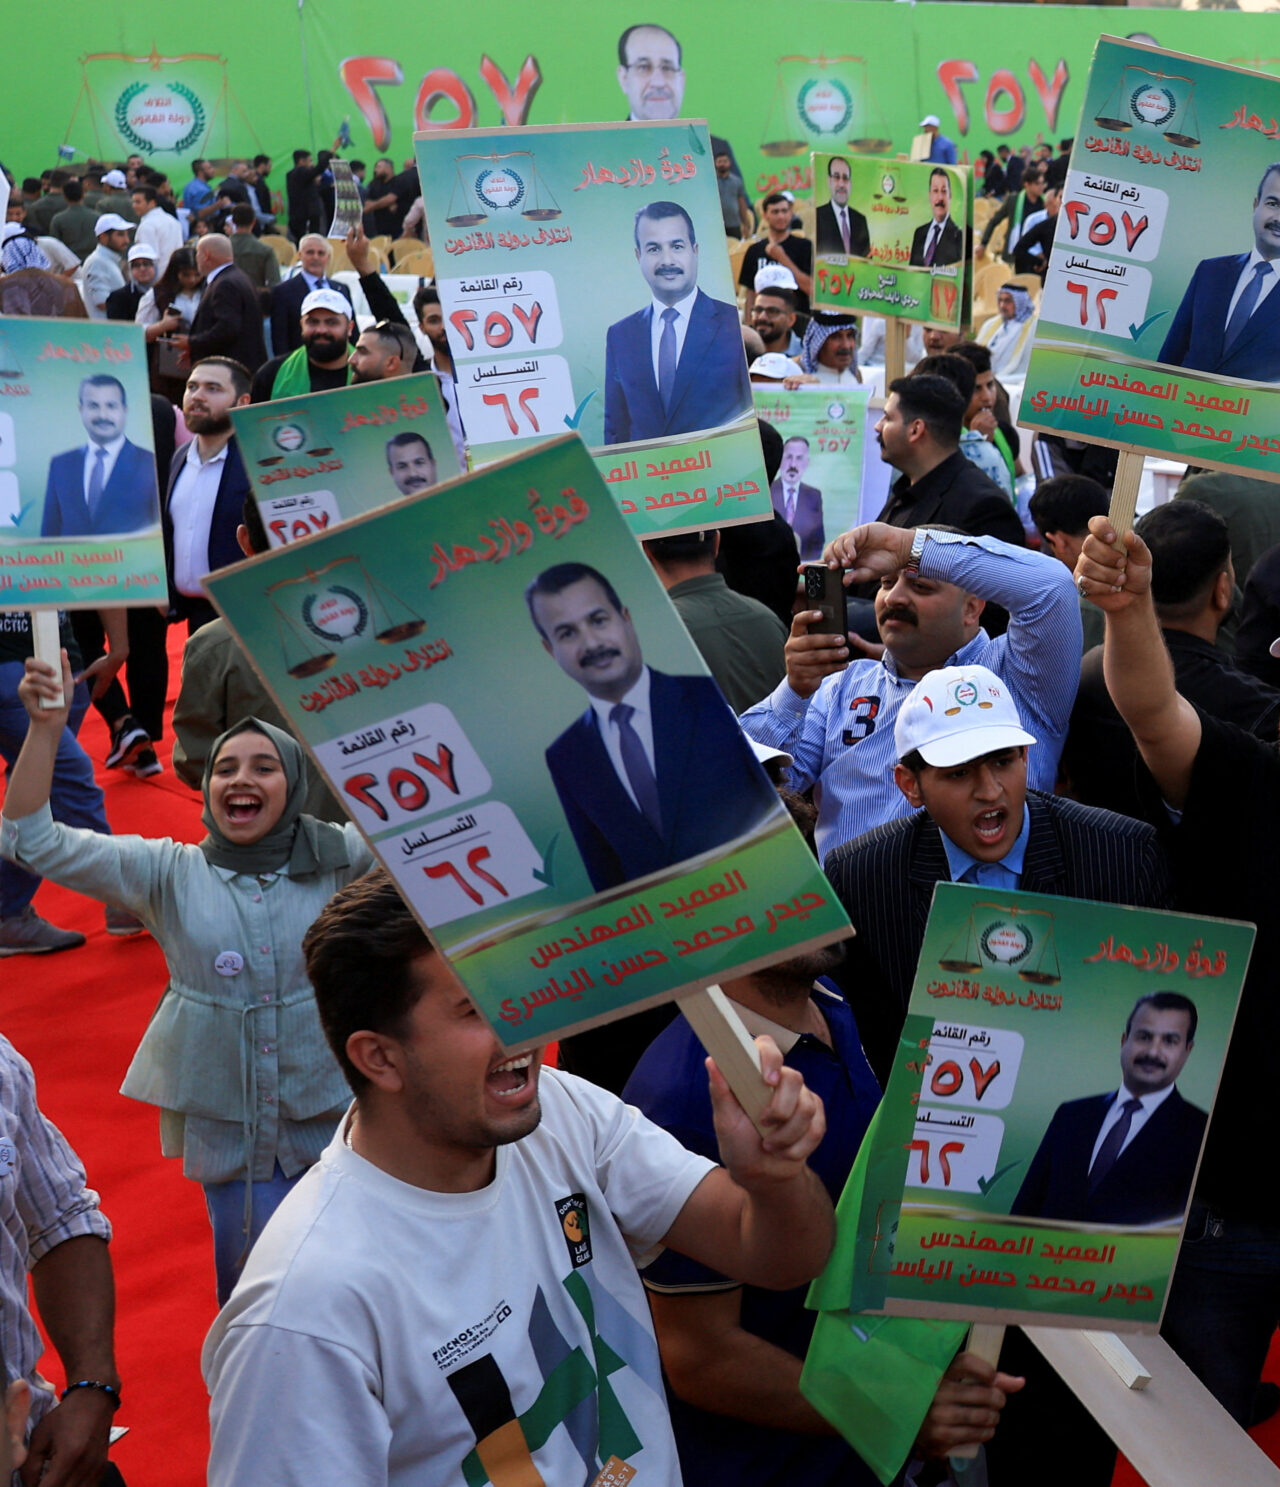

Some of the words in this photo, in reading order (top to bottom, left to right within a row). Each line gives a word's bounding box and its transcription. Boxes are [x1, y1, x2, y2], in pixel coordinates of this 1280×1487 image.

[339, 53, 542, 153] ٢٥٧
[937, 57, 1069, 136] ٢٥٧
[1084, 135, 1130, 156] القانون
[1131, 143, 1162, 165] دولة
[573, 159, 656, 191] وازدهار
[1163, 151, 1203, 173] ائتلاف
[756, 166, 811, 195] لقانون
[1083, 176, 1120, 194] القائمة
[1120, 187, 1140, 202] رقم
[531, 227, 572, 246] ائتلاف
[1064, 200, 1149, 253] ٢٥٧
[445, 232, 494, 255] القانون
[499, 232, 529, 250] دولة
[460, 278, 499, 293] القائمة
[503, 277, 523, 294] رقم
[817, 268, 855, 295] ٢٥٧
[933, 283, 958, 317] ١٧
[1066, 280, 1118, 330] ٦٢
[450, 301, 543, 351] ٢٥٧
[1079, 371, 1179, 401] المهندس
[482, 387, 540, 435] ٦٢
[1030, 389, 1109, 420] الياسري
[1113, 404, 1165, 430] حسن
[1183, 391, 1250, 416] العميد
[339, 405, 398, 434] وازدهار
[1170, 418, 1233, 443] محمد
[818, 437, 851, 452] ٢٥٧
[646, 450, 712, 480] العميد
[645, 487, 707, 511] محمد
[715, 480, 760, 507] حيدر
[269, 510, 329, 545] ٢٥٧
[0, 550, 64, 566] المهند
[71, 549, 123, 567] العميد
[428, 516, 534, 590] وازدهار
[68, 574, 117, 587] محمد
[401, 638, 454, 672] ائتلاف
[358, 662, 402, 689] دولة
[299, 672, 361, 713] القانون
[390, 719, 416, 744] رقم
[842, 695, 881, 746] 3
[338, 728, 387, 756] القائمة
[344, 742, 461, 822] ٢٥٧
[422, 845, 509, 906] ٦٢
[658, 868, 749, 920] العميد
[763, 890, 827, 934] حيدر
[529, 902, 655, 970] المهندس
[673, 915, 756, 957] محمد
[600, 948, 670, 986] حسن
[1083, 934, 1180, 974] وازدهار
[498, 967, 597, 1026] الياسري
[926, 979, 980, 1000] القانون
[982, 985, 1016, 1006] دولة
[1018, 989, 1063, 1011] ائتلاف
[932, 1026, 967, 1040] القائم
[968, 1031, 991, 1047] رقم
[926, 1055, 1000, 1101] ٥٧
[916, 1111, 975, 1128] التسلس
[904, 1139, 965, 1186] ٦٢
[920, 1229, 1034, 1257] المهندس
[1039, 1245, 1116, 1264] العميد
[890, 1258, 953, 1285] الياس
[959, 1263, 1017, 1287] حسن
[1026, 1273, 1095, 1295] محمد
[1098, 1281, 1154, 1305] حيدر
[432, 1328, 473, 1361] FIUCNOS
